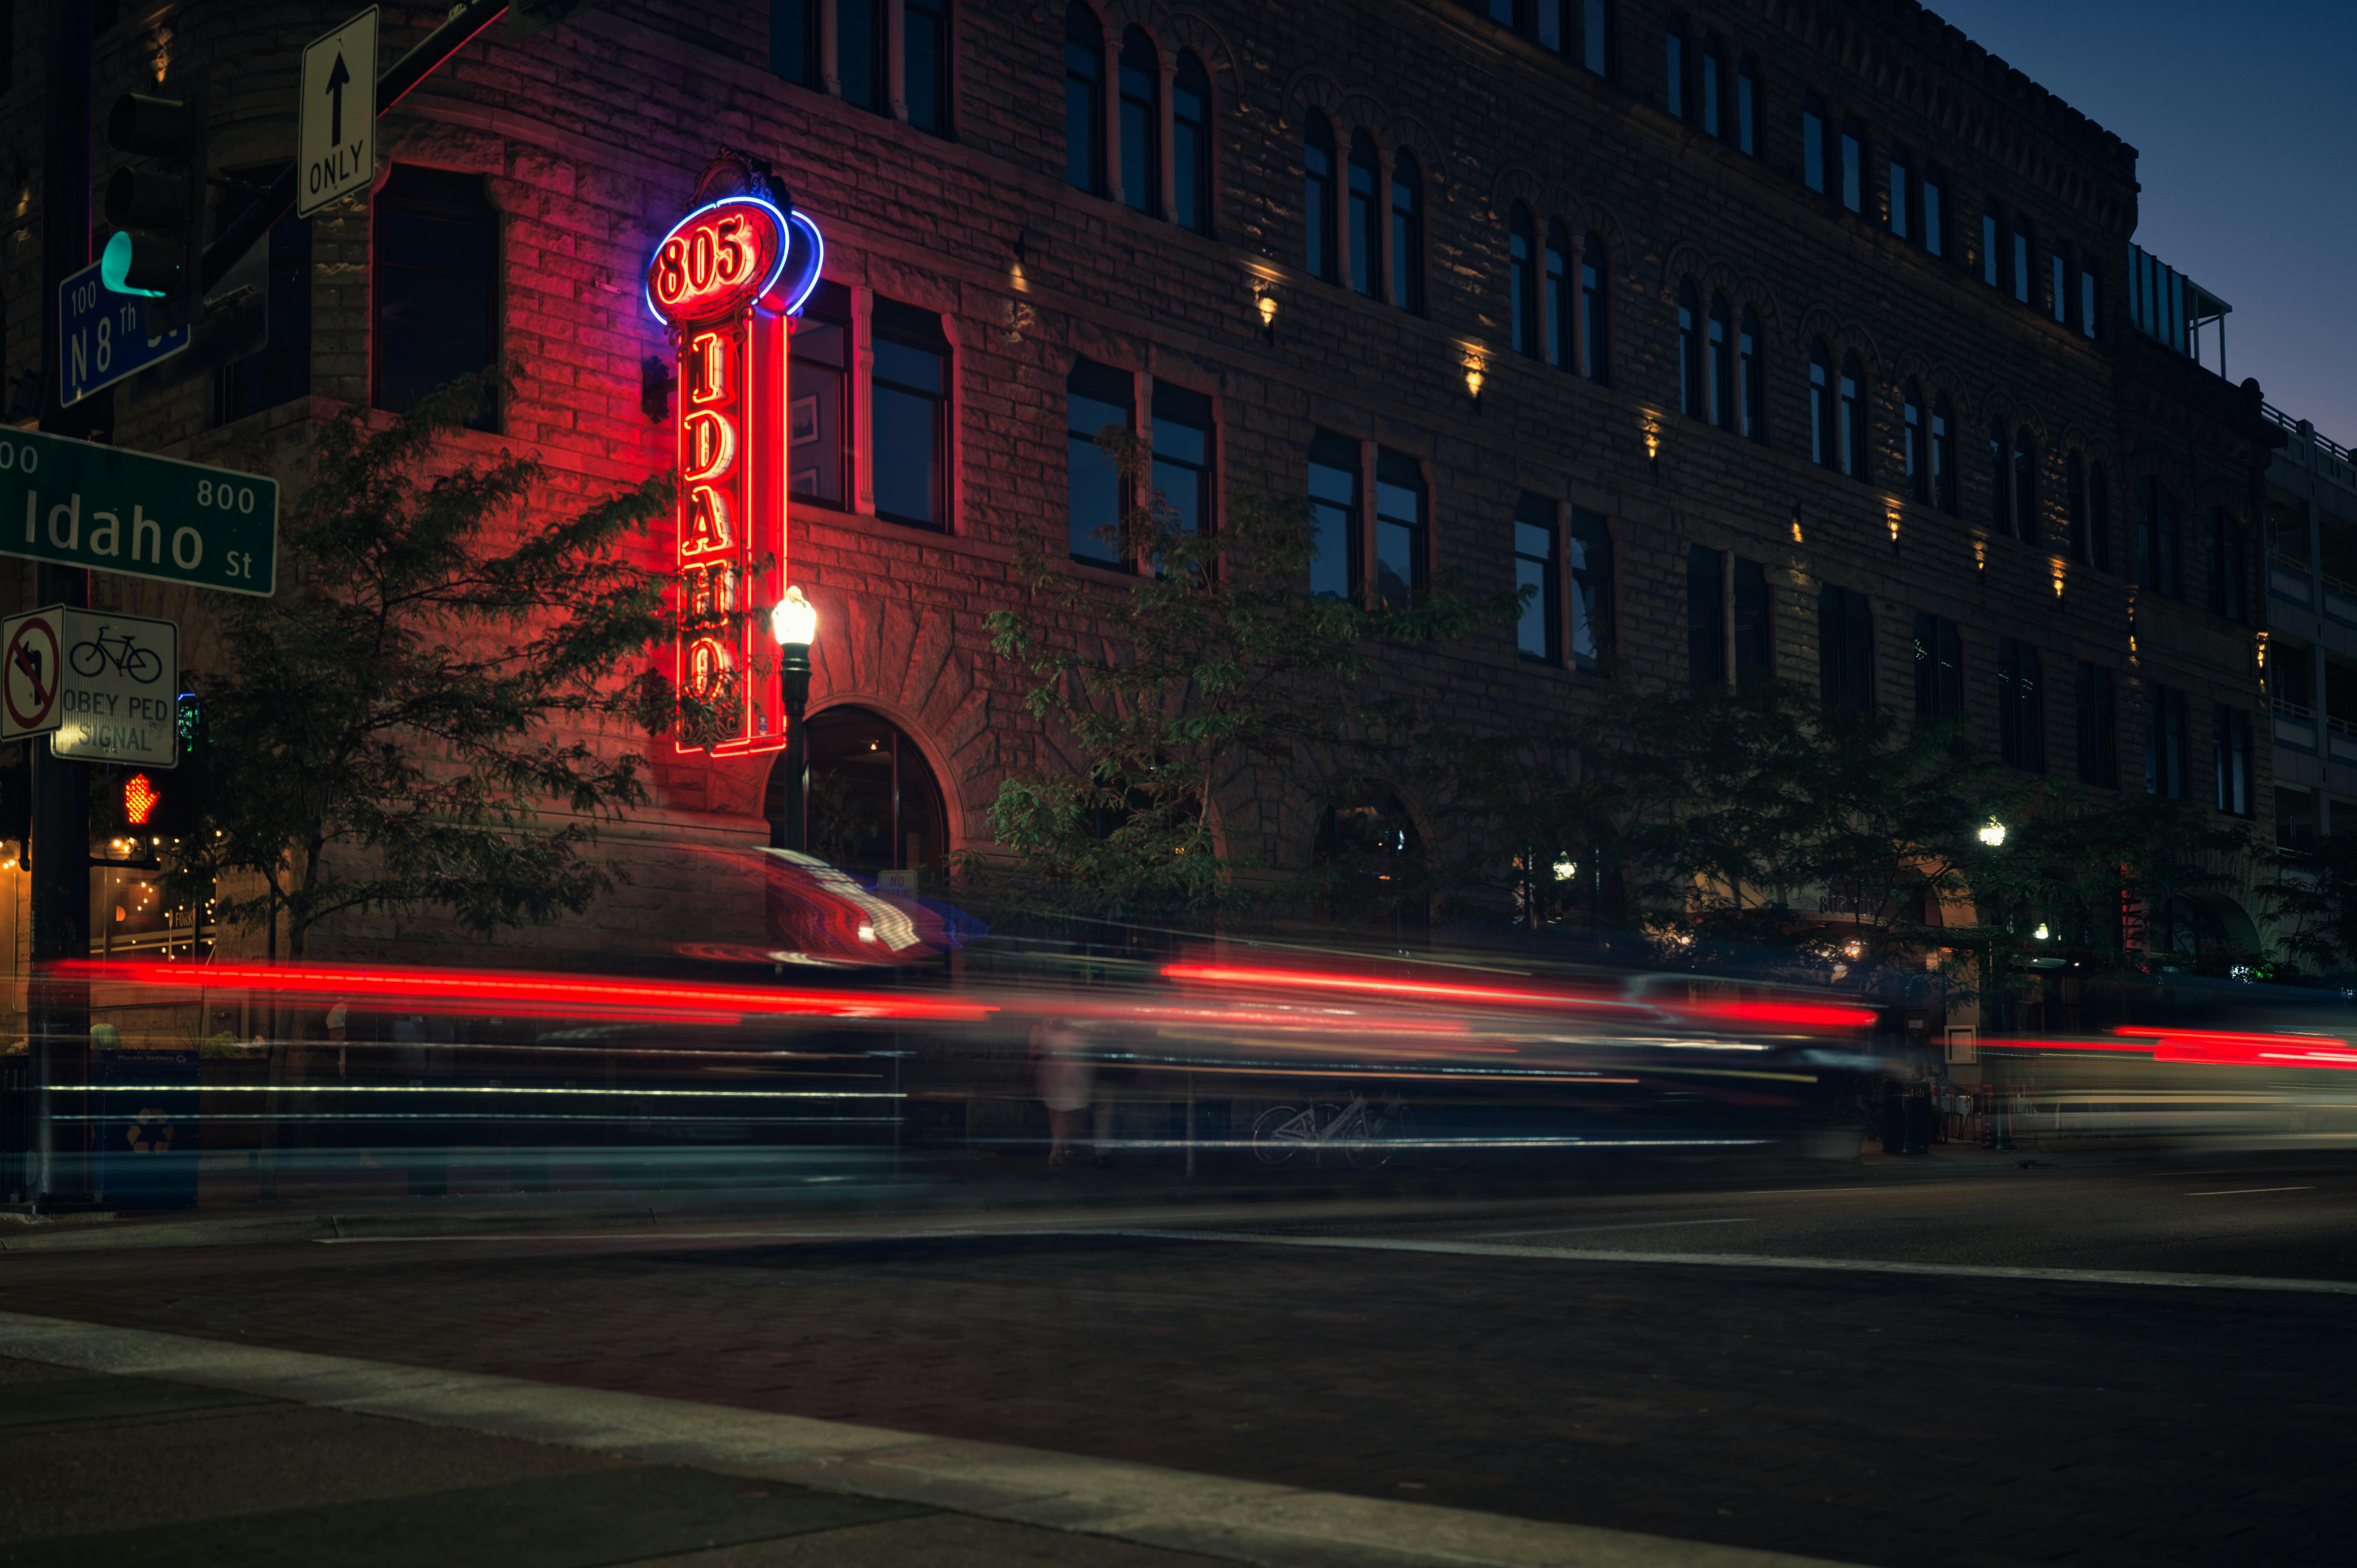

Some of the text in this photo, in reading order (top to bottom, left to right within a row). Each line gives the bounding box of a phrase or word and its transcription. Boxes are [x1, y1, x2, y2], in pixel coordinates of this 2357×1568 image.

[310, 139, 363, 194] ONLY
[657, 214, 746, 304] 805
[72, 280, 96, 318] 100
[72, 327, 87, 387] N
[197, 479, 255, 514] 800
[25, 489, 253, 579] Idaho St
[681, 332, 730, 704] IDAHO
[63, 689, 168, 722] OBEY PED
[79, 723, 152, 751] SIGNAL
[882, 888, 914, 899] PARKING
[890, 876, 904, 886] NO
[175, 910, 193, 928] FORK
